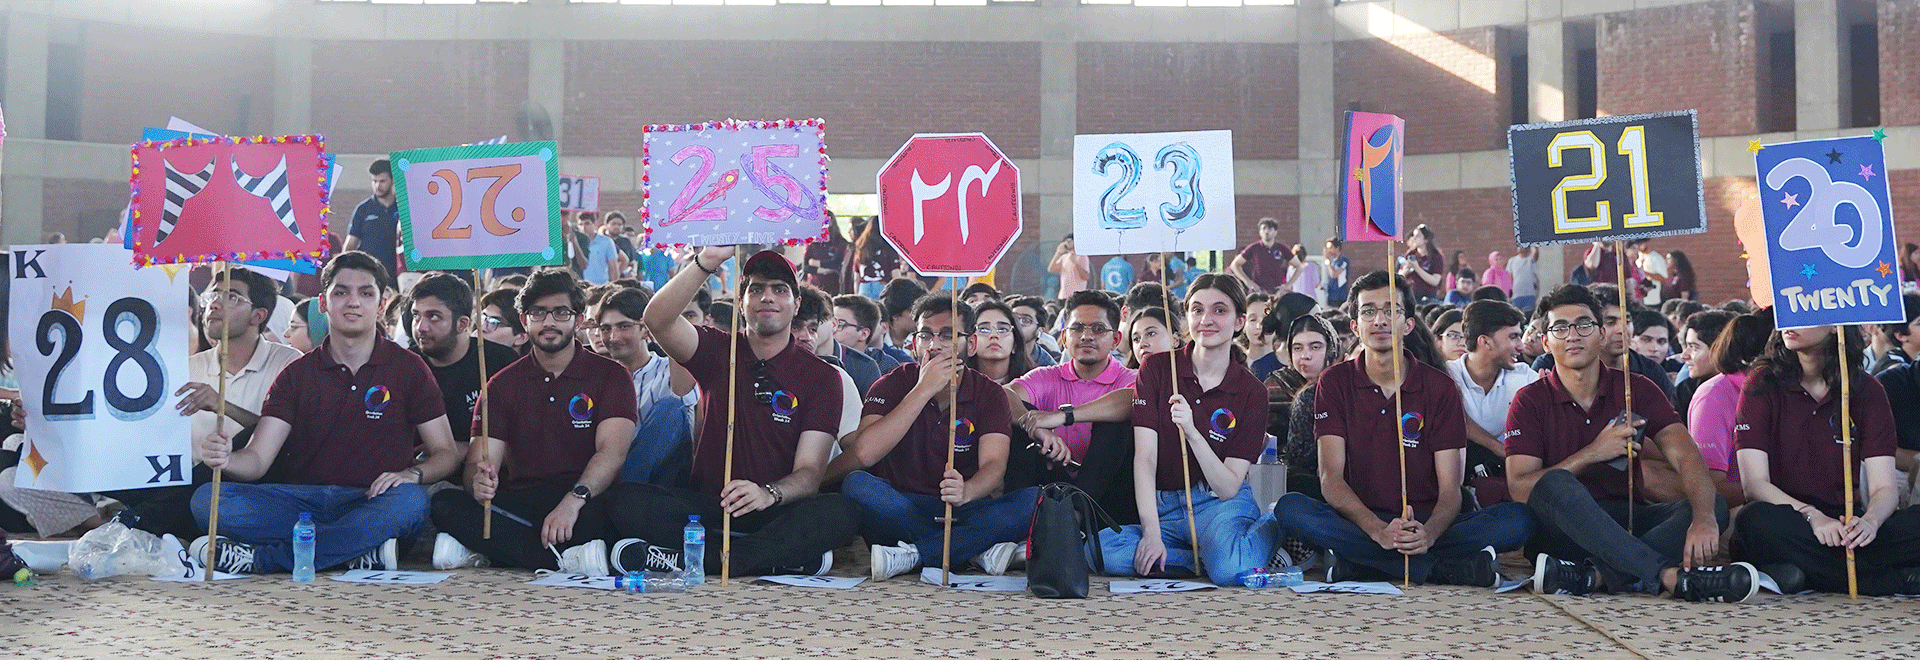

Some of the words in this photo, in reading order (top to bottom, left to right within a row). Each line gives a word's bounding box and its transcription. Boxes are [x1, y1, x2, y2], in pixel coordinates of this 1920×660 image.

[427, 163, 526, 240] 27
[668, 144, 804, 223] 25
[1091, 141, 1207, 230] 23
[1547, 125, 1664, 234] 21
[1766, 157, 1883, 268] 20
[13, 249, 47, 279] K
[687, 231, 776, 246] TWENTY-FIVE
[1780, 278, 1893, 313] TWENTY
[35, 296, 170, 422] 28
[145, 454, 184, 484] K
